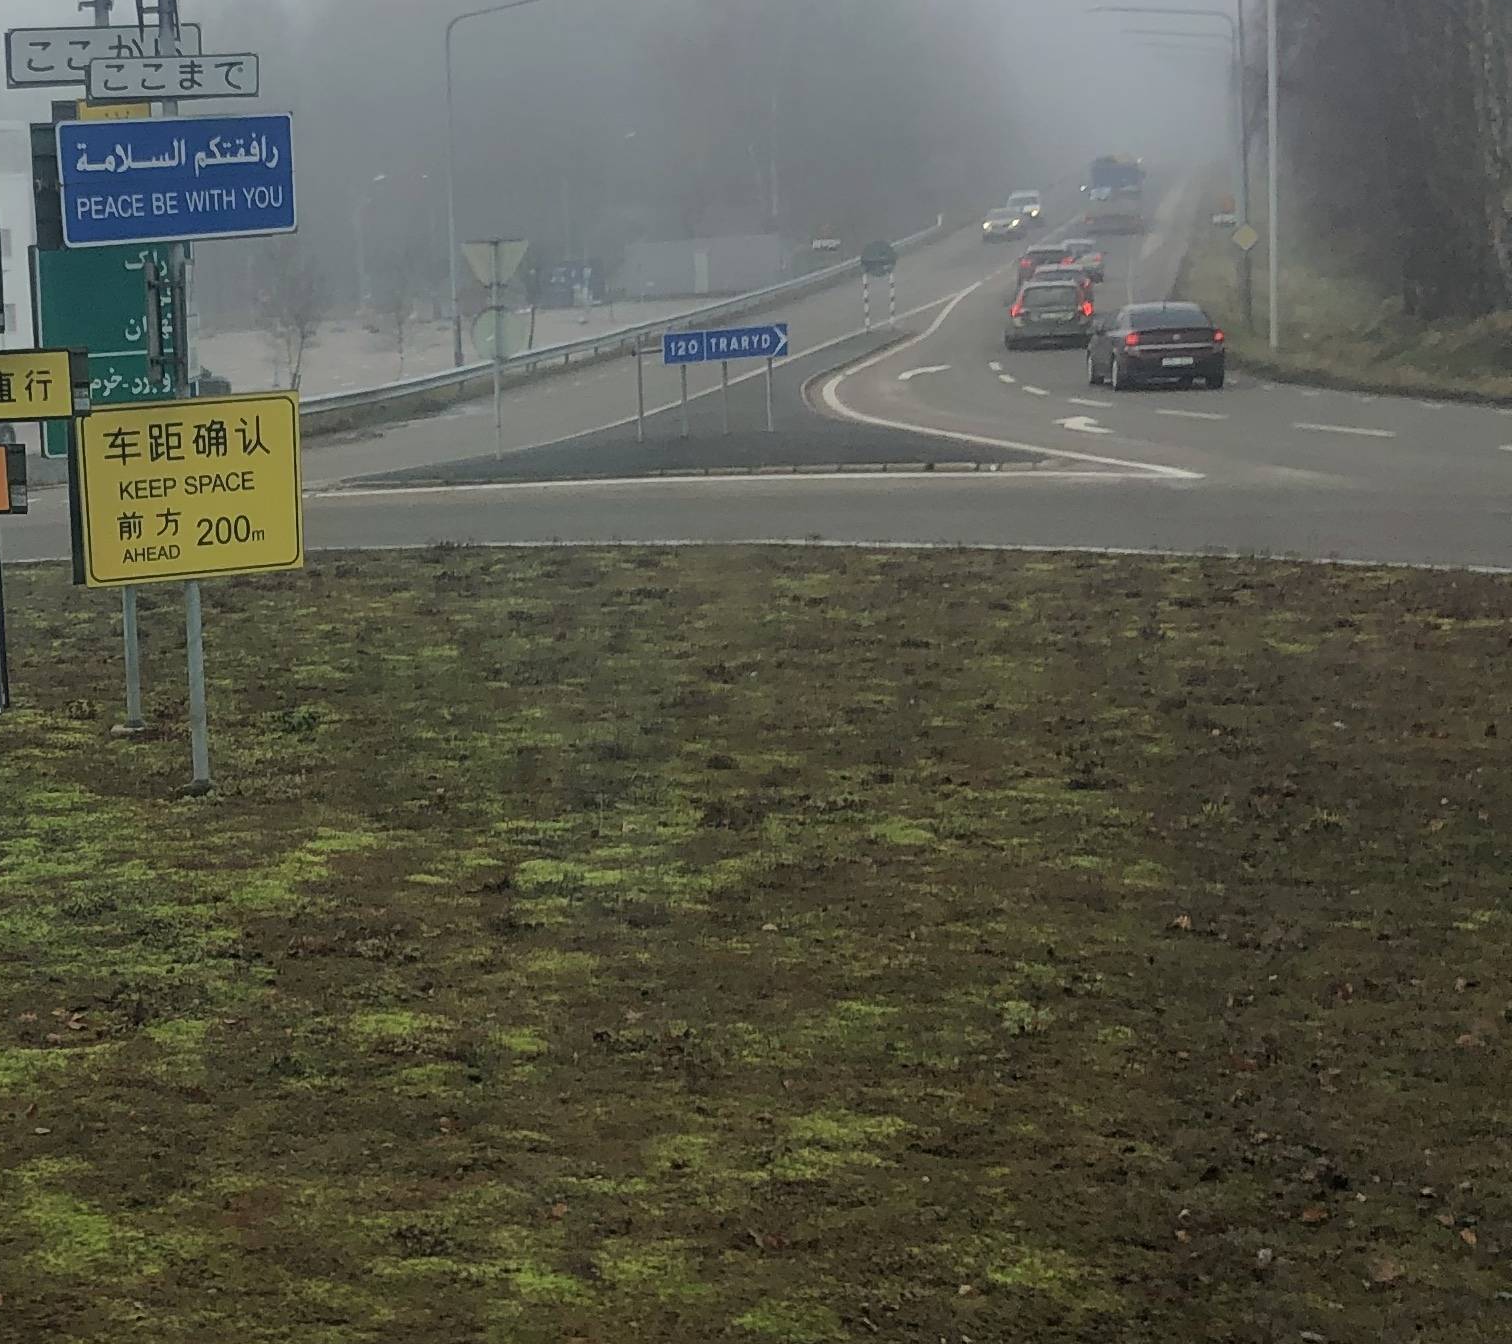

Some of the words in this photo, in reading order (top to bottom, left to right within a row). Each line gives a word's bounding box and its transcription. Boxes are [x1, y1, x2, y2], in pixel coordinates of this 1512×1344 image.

[104, 59, 245, 91] ここまで
[76, 138, 186, 173] السلامة
[194, 133, 279, 177] رافقتكم
[76, 194, 145, 220] PEACE
[151, 192, 179, 216] BE
[185, 188, 236, 213] WITH
[242, 185, 284, 209] YOU
[670, 339, 699, 356] 120
[709, 334, 771, 353] TRARYD
[103, 415, 271, 466] 车距确认
[119, 477, 177, 501] KEEP
[184, 471, 255, 496] SPACE
[116, 507, 182, 542] 前方
[196, 514, 265, 546] 200m
[122, 544, 181, 564] AHEAD
